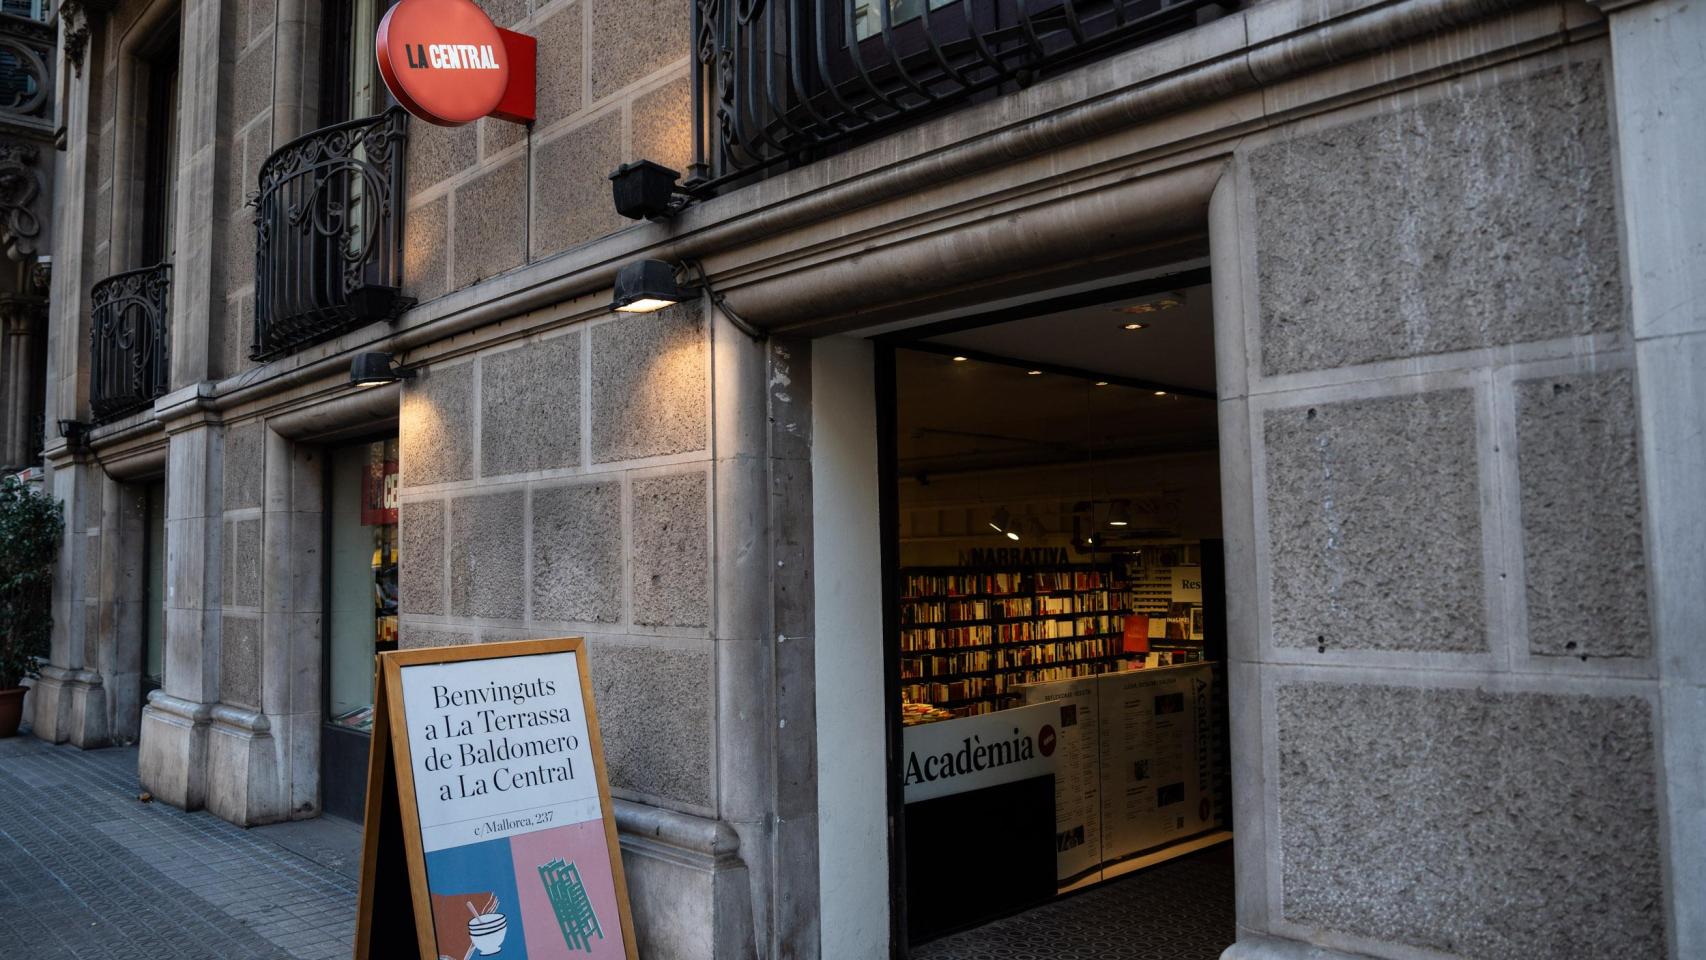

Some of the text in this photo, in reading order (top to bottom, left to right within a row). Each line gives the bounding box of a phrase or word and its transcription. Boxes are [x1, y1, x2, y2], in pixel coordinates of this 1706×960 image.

[405, 44, 500, 69] LA CENTRAL
[971, 547, 1068, 566] NARRATIVA
[433, 677, 556, 709] Benvinguts
[425, 706, 571, 741] a La Terrassa
[424, 735, 579, 772] de Baldomero
[904, 727, 1035, 786] Acadèmia
[439, 757, 575, 801] a La Central
[474, 810, 554, 838] c/Mallorca, 237
